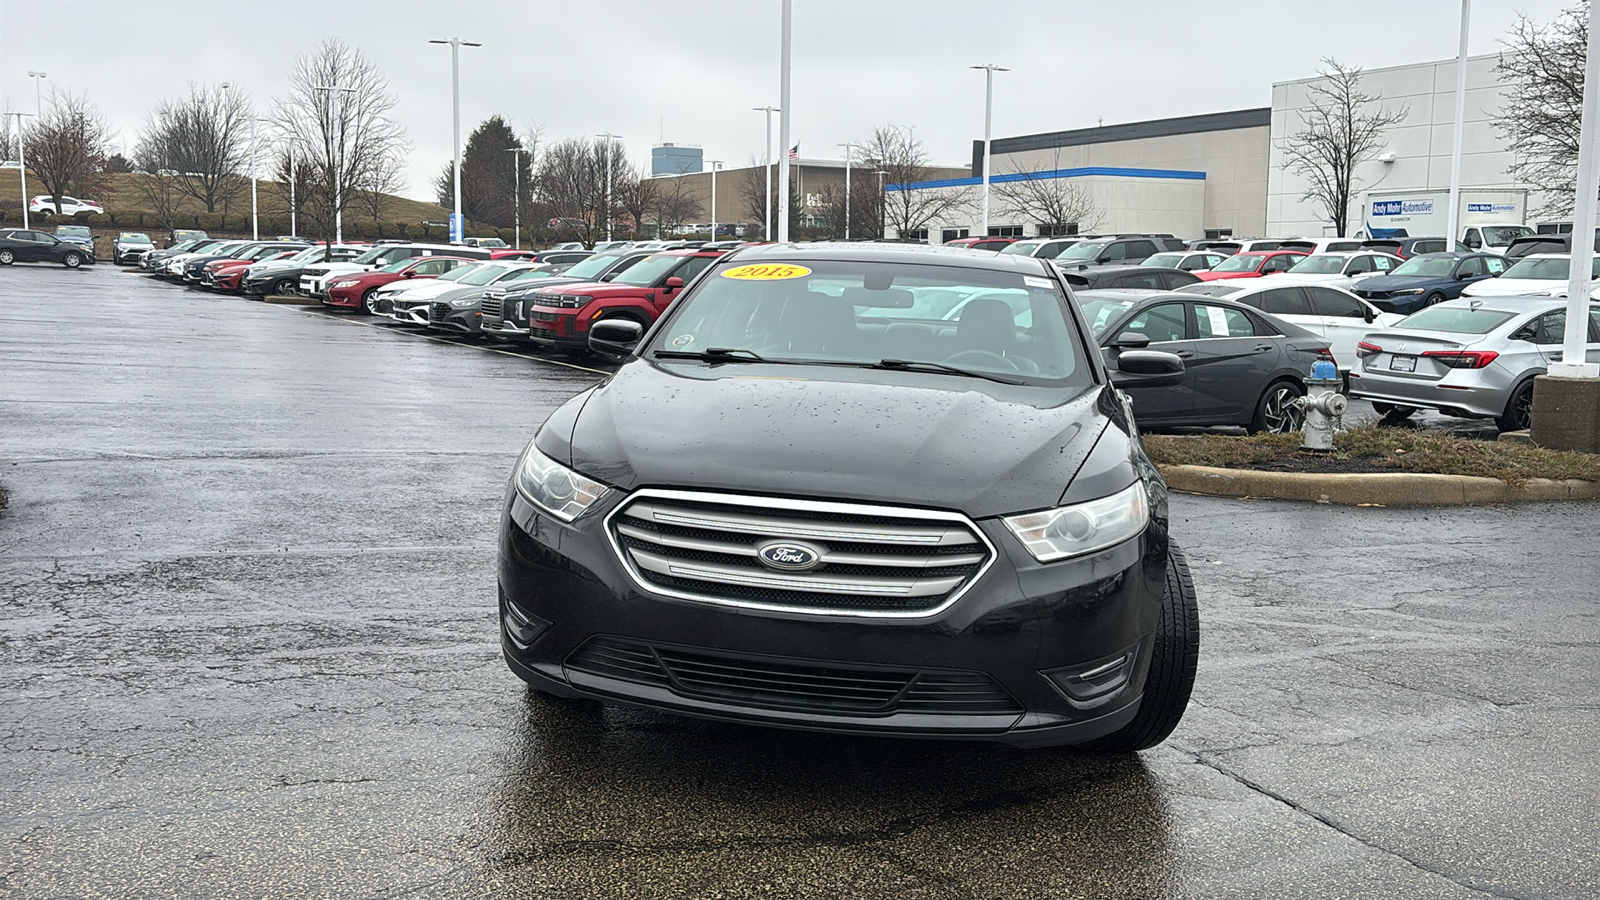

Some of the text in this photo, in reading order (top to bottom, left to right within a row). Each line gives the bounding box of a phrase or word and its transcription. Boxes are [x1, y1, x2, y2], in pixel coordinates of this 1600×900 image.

[1373, 201, 1432, 215] Andy Mohr Automotive
[734, 266, 798, 277] 2015
[772, 547, 804, 562] Ford
